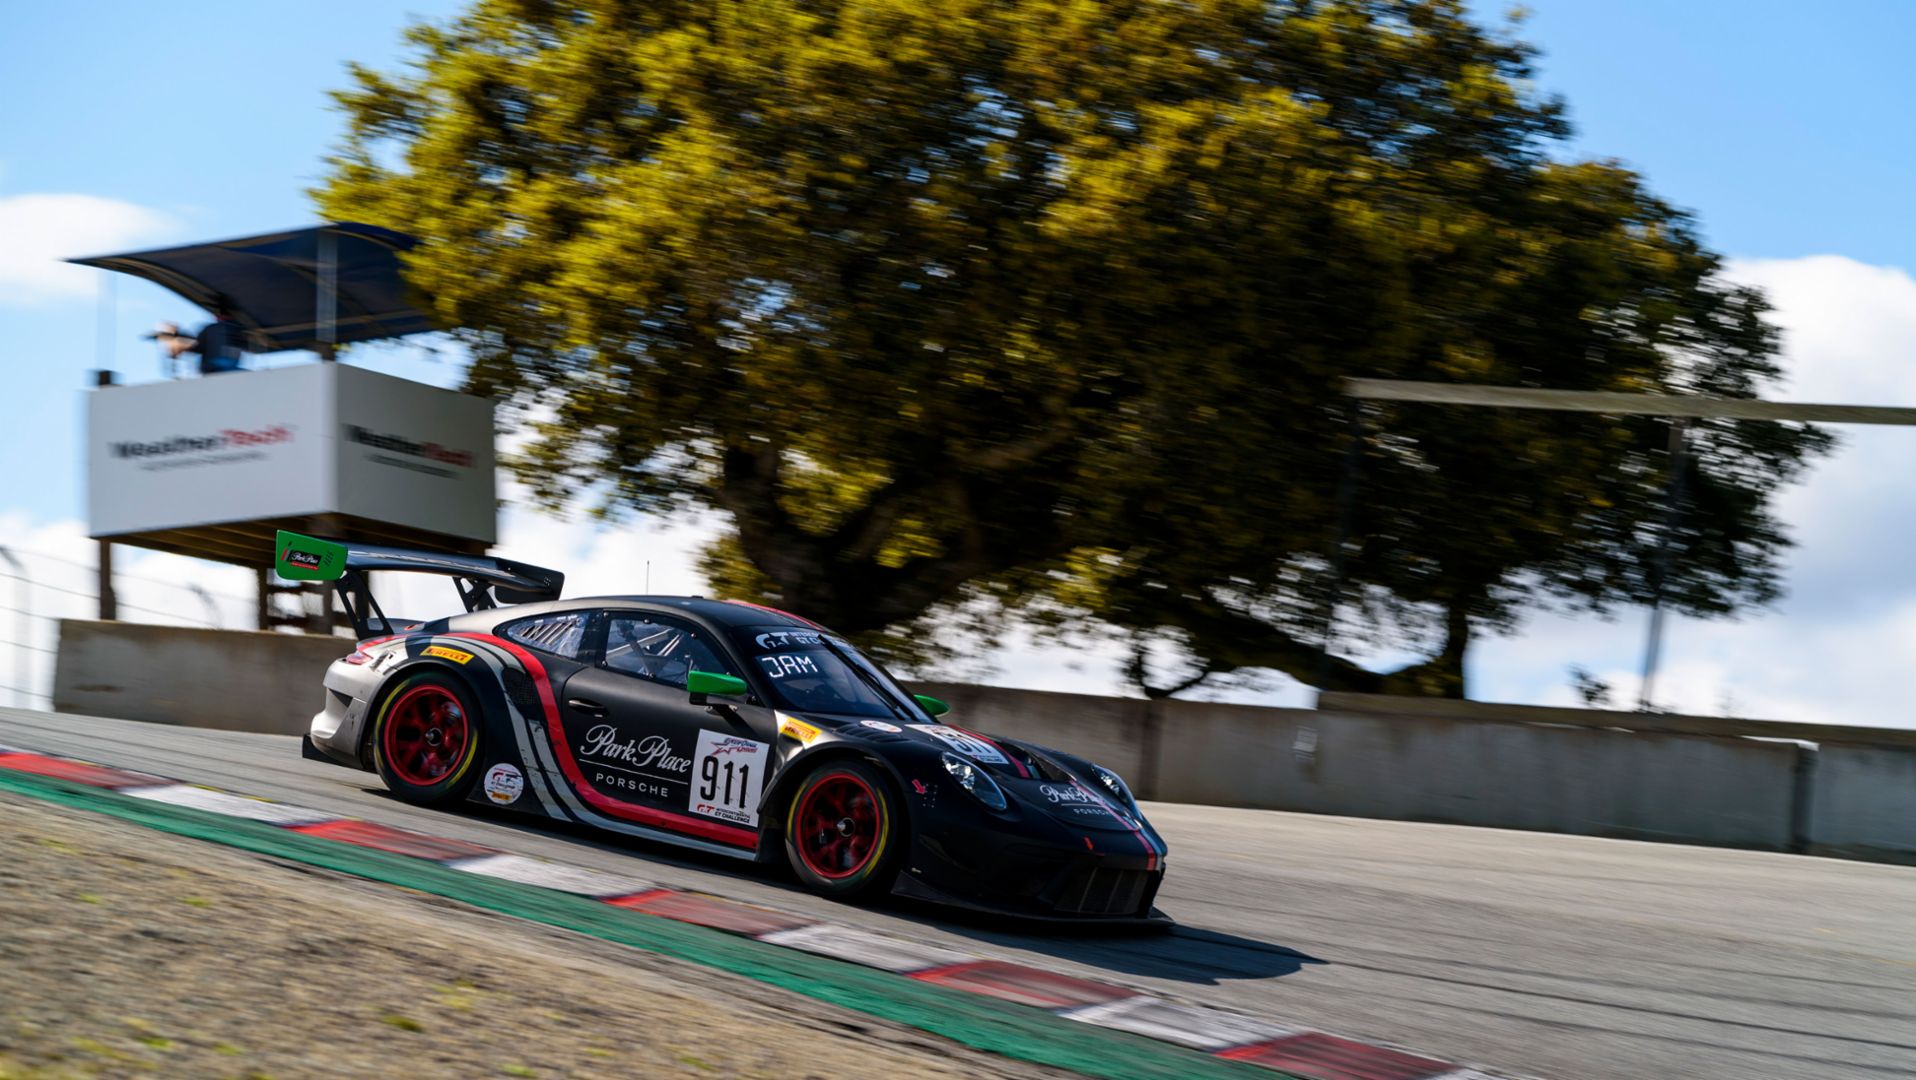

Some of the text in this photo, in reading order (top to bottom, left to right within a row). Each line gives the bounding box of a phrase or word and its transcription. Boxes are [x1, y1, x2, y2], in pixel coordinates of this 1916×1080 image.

[761, 655, 819, 678] JAM
[580, 724, 692, 773] Park Place
[595, 772, 669, 798] PORSCHE
[700, 755, 750, 809] 911
